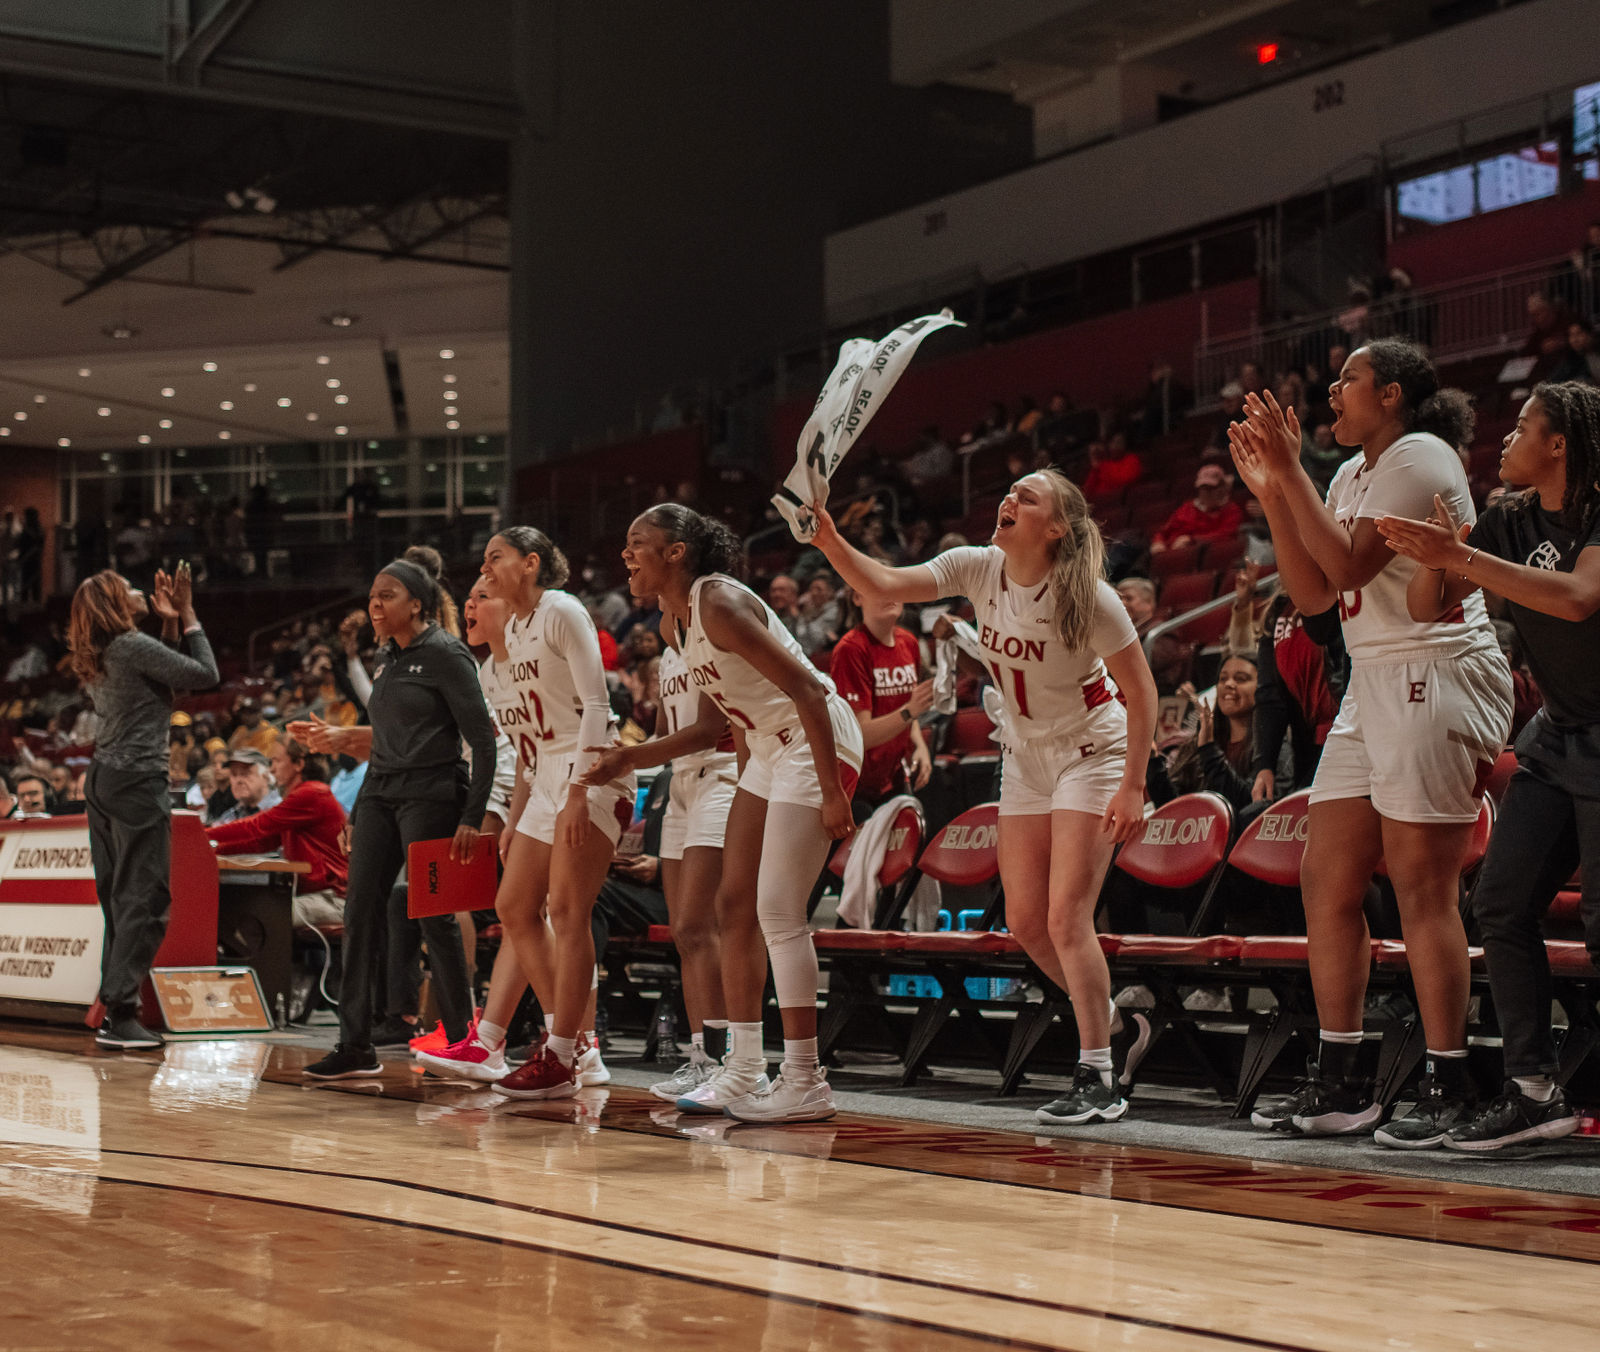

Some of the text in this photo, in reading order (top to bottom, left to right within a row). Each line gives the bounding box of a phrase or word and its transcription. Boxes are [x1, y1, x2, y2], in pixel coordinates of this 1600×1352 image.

[872, 339, 901, 377] READY
[845, 389, 872, 439] READY
[980, 624, 1047, 662] ELON
[509, 659, 539, 682] LON
[873, 664, 917, 688] ELON
[1408, 681, 1427, 703] E
[776, 728, 793, 747] E
[1080, 742, 1096, 758] E
[1141, 814, 1216, 845] ELON
[1254, 814, 1309, 841] ELO
[429, 861, 438, 894] NCAA
[24, 936, 71, 956] WEBSITE
[71, 938, 90, 957] OF
